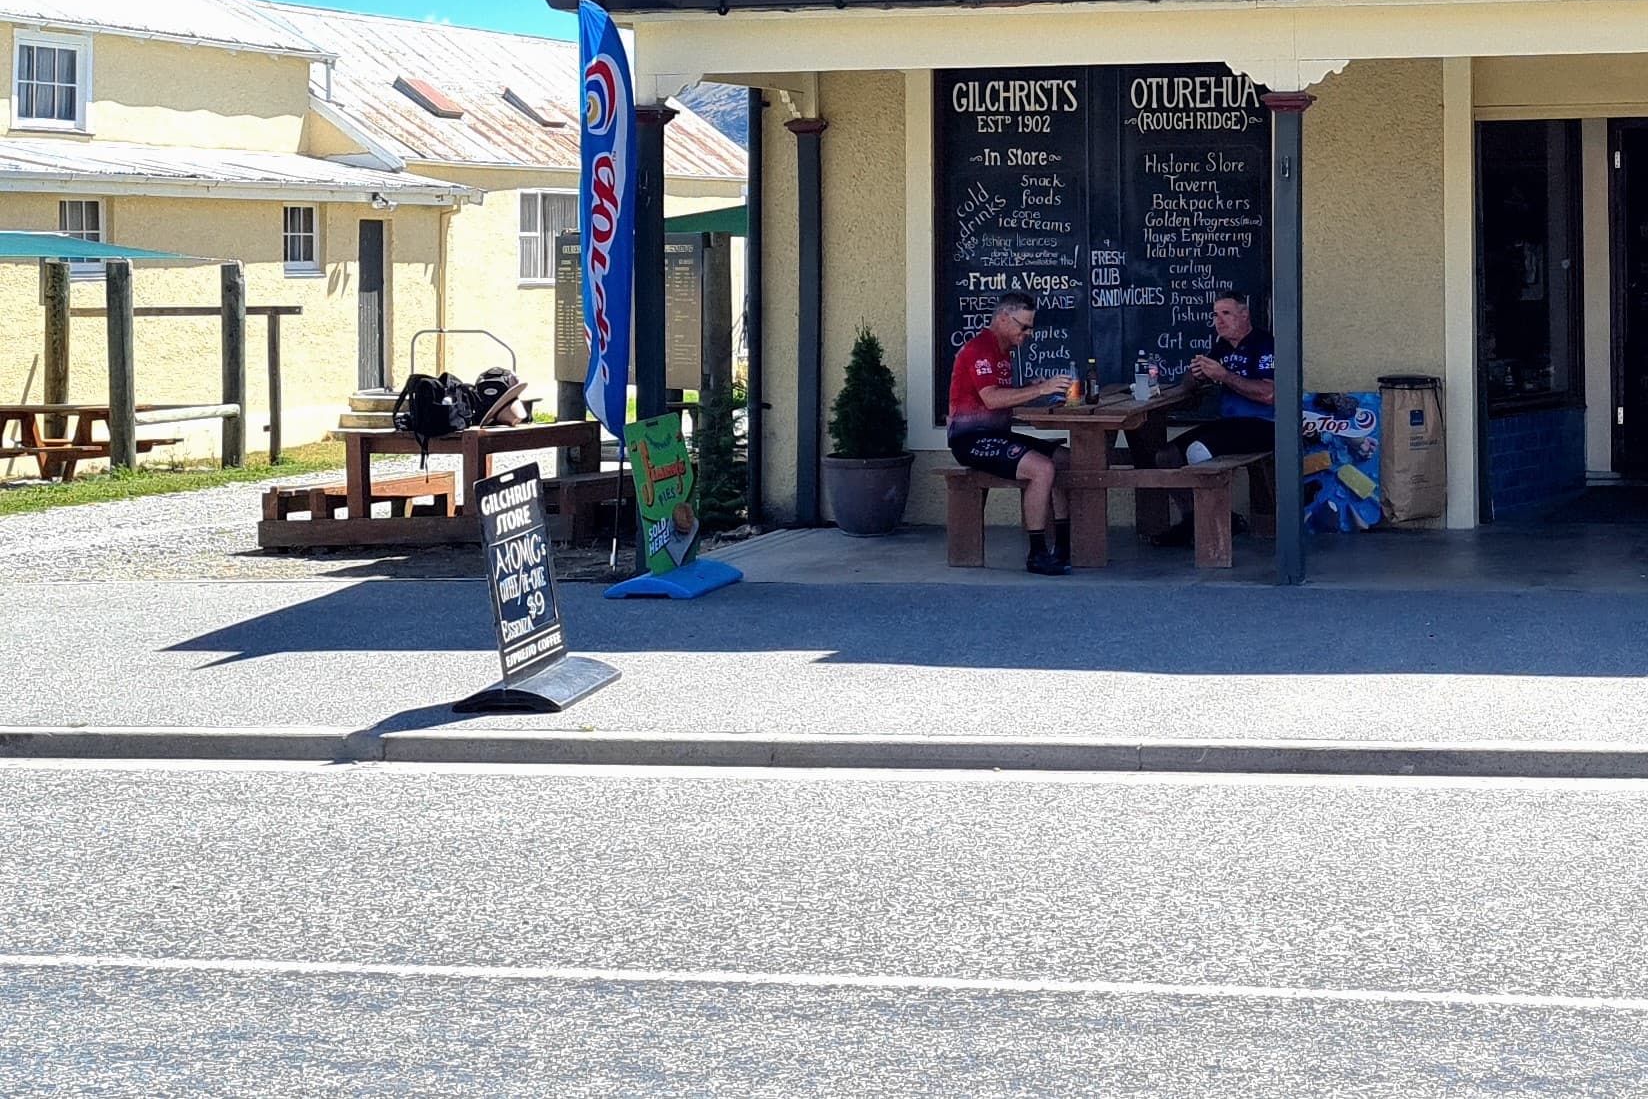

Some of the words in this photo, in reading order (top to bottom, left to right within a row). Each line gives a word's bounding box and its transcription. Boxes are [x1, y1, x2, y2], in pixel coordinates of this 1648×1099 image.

[952, 80, 1078, 112] GILCHRISTS
[1130, 76, 1260, 109] OTUREHUA
[1018, 115, 1051, 132] 1902
[984, 149, 1001, 165] In
[1008, 149, 1047, 165] Store
[1144, 153, 1200, 173] Historic
[1205, 152, 1245, 172] Store
[1021, 174, 1065, 188] Snack
[1164, 174, 1220, 193] Tavern
[956, 181, 989, 217] cold
[1021, 188, 1062, 208] foods
[1152, 193, 1251, 212] Backpackers
[959, 194, 1007, 238] drinks
[999, 214, 1017, 228] ice
[1021, 218, 1072, 233] creams
[1145, 211, 1190, 227] Golden
[1143, 228, 1177, 247] Hayes
[1181, 228, 1252, 247] Engineering
[1091, 251, 1126, 265] FRESH
[1207, 244, 1241, 258] Dam
[1091, 268, 1121, 285] CLUB
[1169, 260, 1212, 279] curling
[968, 272, 1006, 290] Fruit
[1011, 276, 1021, 289] &
[1022, 272, 1069, 295] Veges
[1171, 280, 1187, 289] ice
[1192, 276, 1233, 290] skating
[959, 297, 999, 311] FRES
[1036, 296, 1075, 310] MADE
[1170, 292, 1203, 305] Brass
[1171, 306, 1216, 327] fishing
[1031, 326, 1068, 340] pples
[1157, 332, 1183, 349] Art
[1189, 334, 1212, 350] and
[1028, 344, 1071, 363] Spuds
[1024, 362, 1067, 377] Banan
[1318, 416, 1349, 433] Top
[481, 478, 538, 516] GILCHRIST
[496, 504, 532, 536] STORE
[648, 518, 667, 541] SOLD
[648, 529, 670, 556] HERE!
[527, 591, 545, 619] $9
[537, 631, 562, 651] COFFEE
